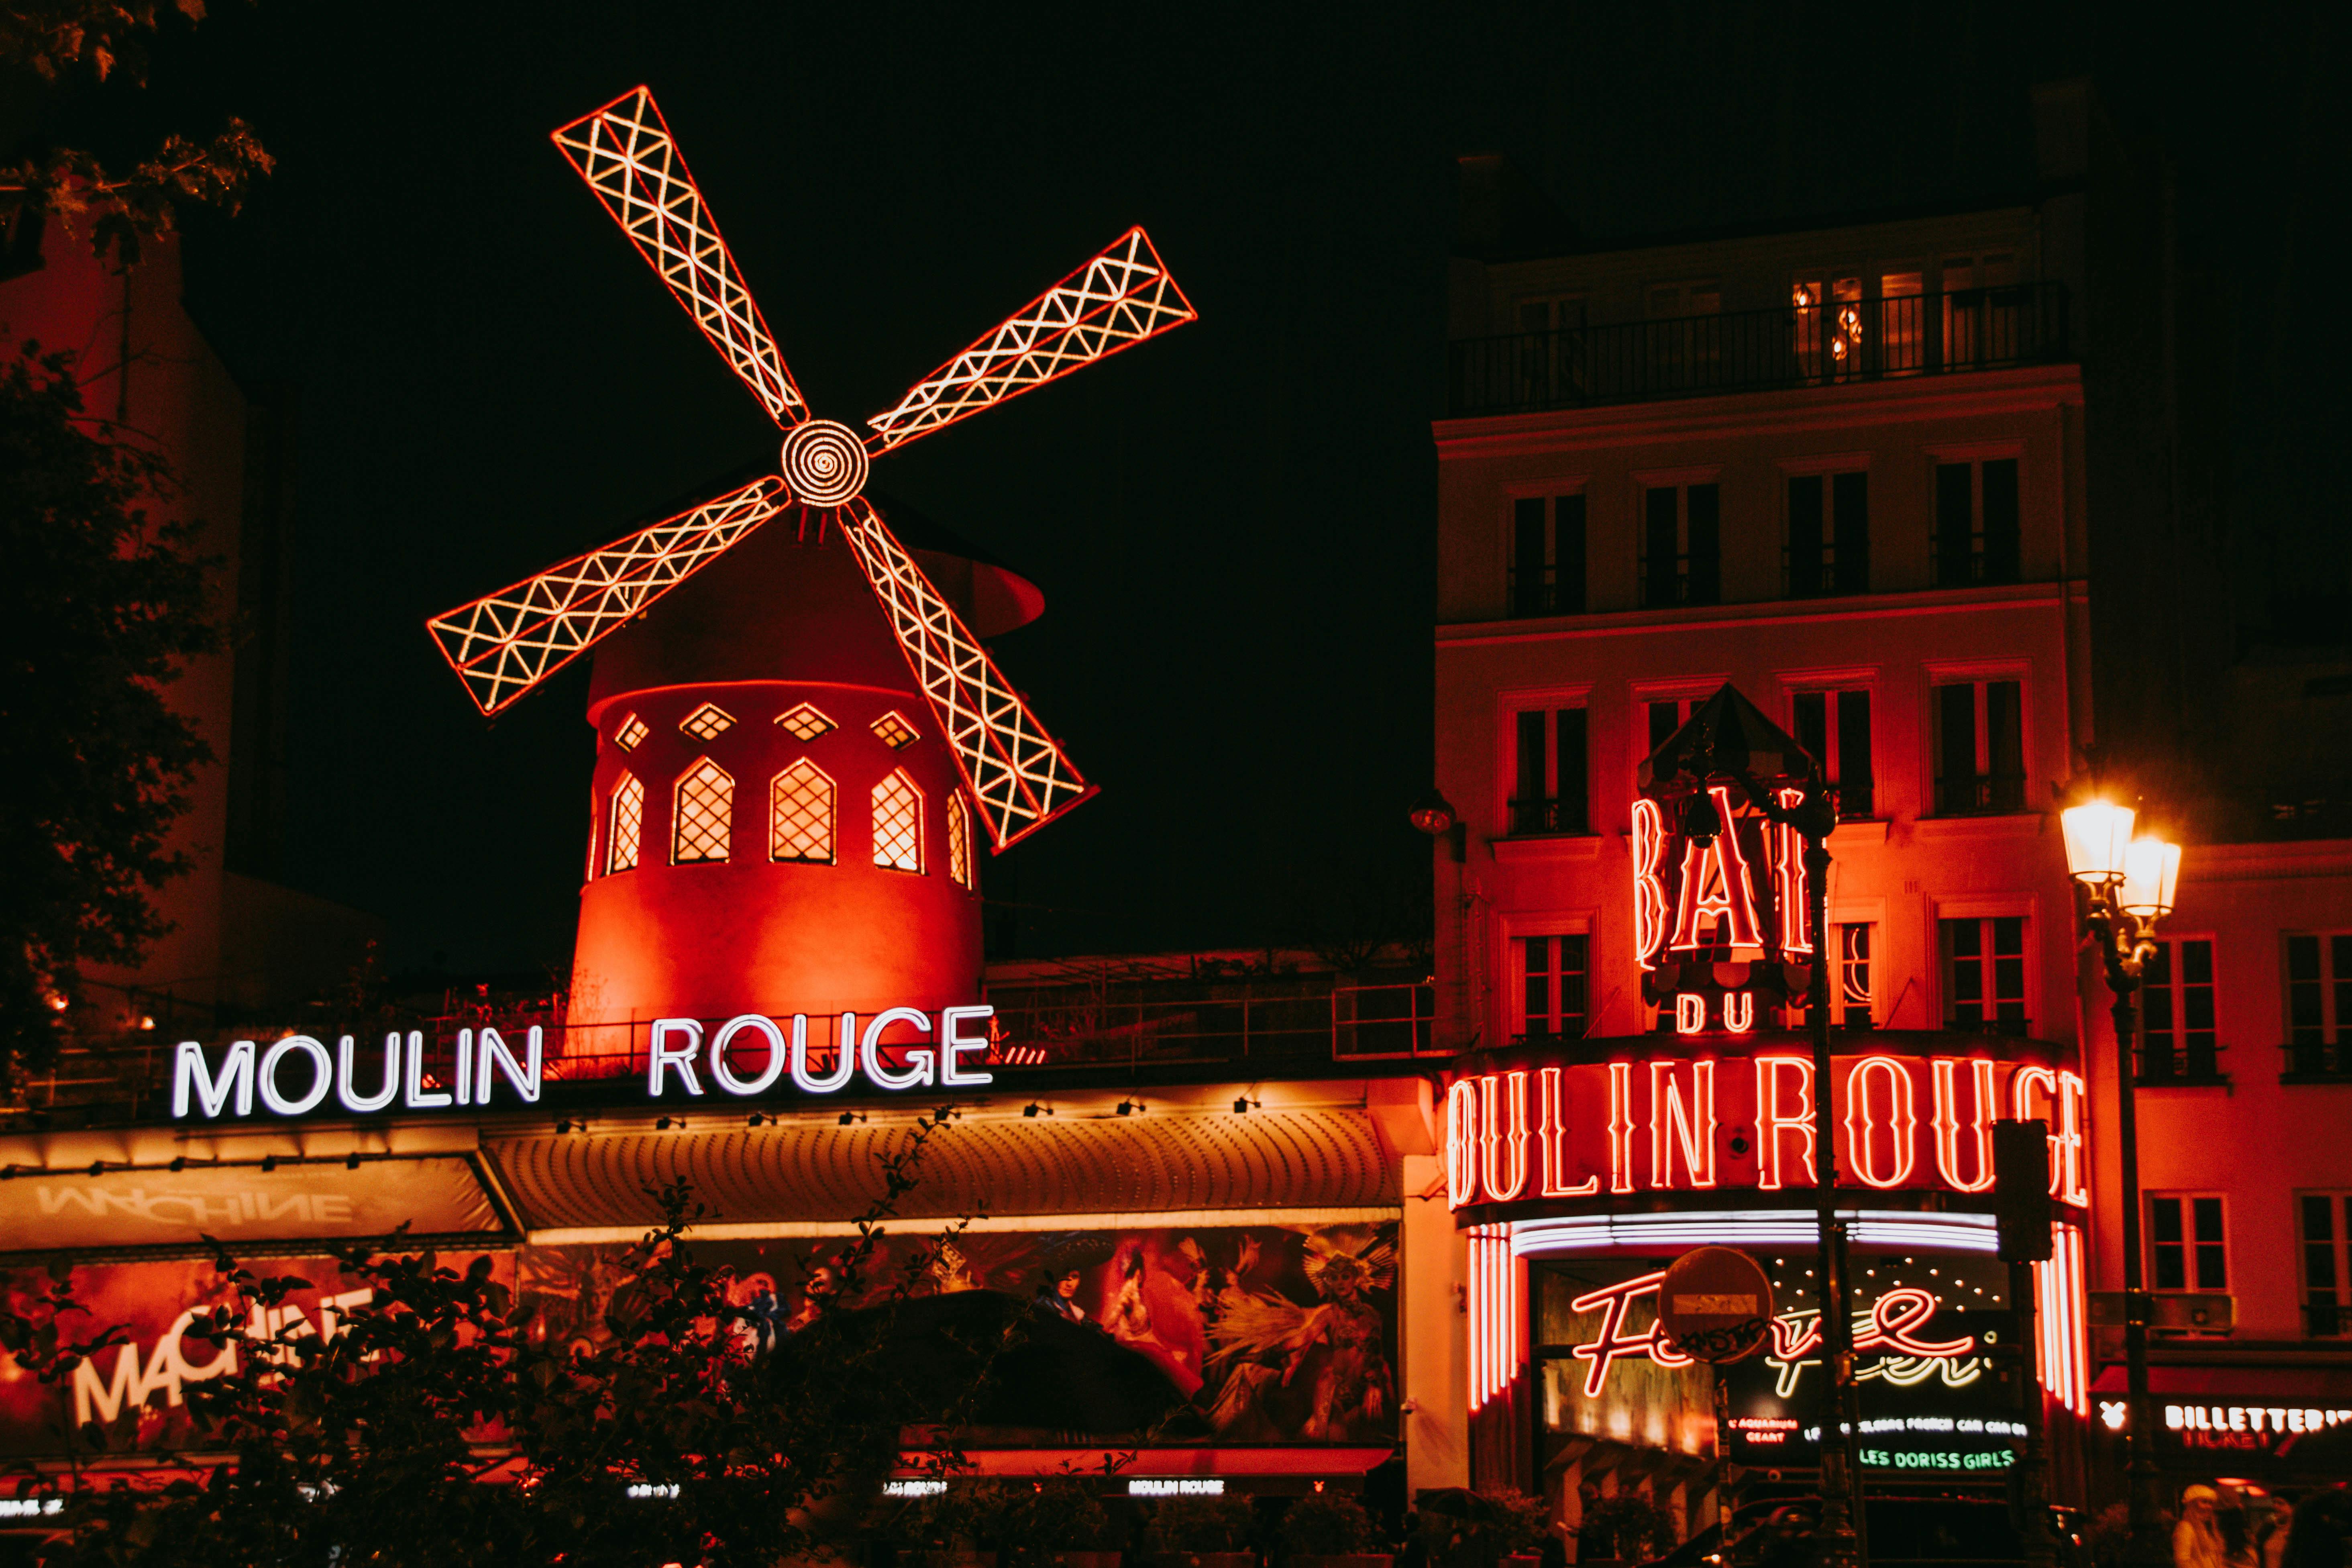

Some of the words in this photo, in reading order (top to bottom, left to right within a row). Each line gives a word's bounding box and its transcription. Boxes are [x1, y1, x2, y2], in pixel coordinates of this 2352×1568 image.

[1677, 993, 1754, 1034] DU
[173, 1025, 544, 1118] MOULIN
[649, 1005, 994, 1097] ROUGE
[1447, 1060, 1717, 1212] OULIN
[1753, 1055, 2088, 1208] ROUGE
[1859, 1448, 1890, 1466] LES
[1895, 1452, 1961, 1469] DORISS
[1963, 1450, 2015, 1470] GIRLS
